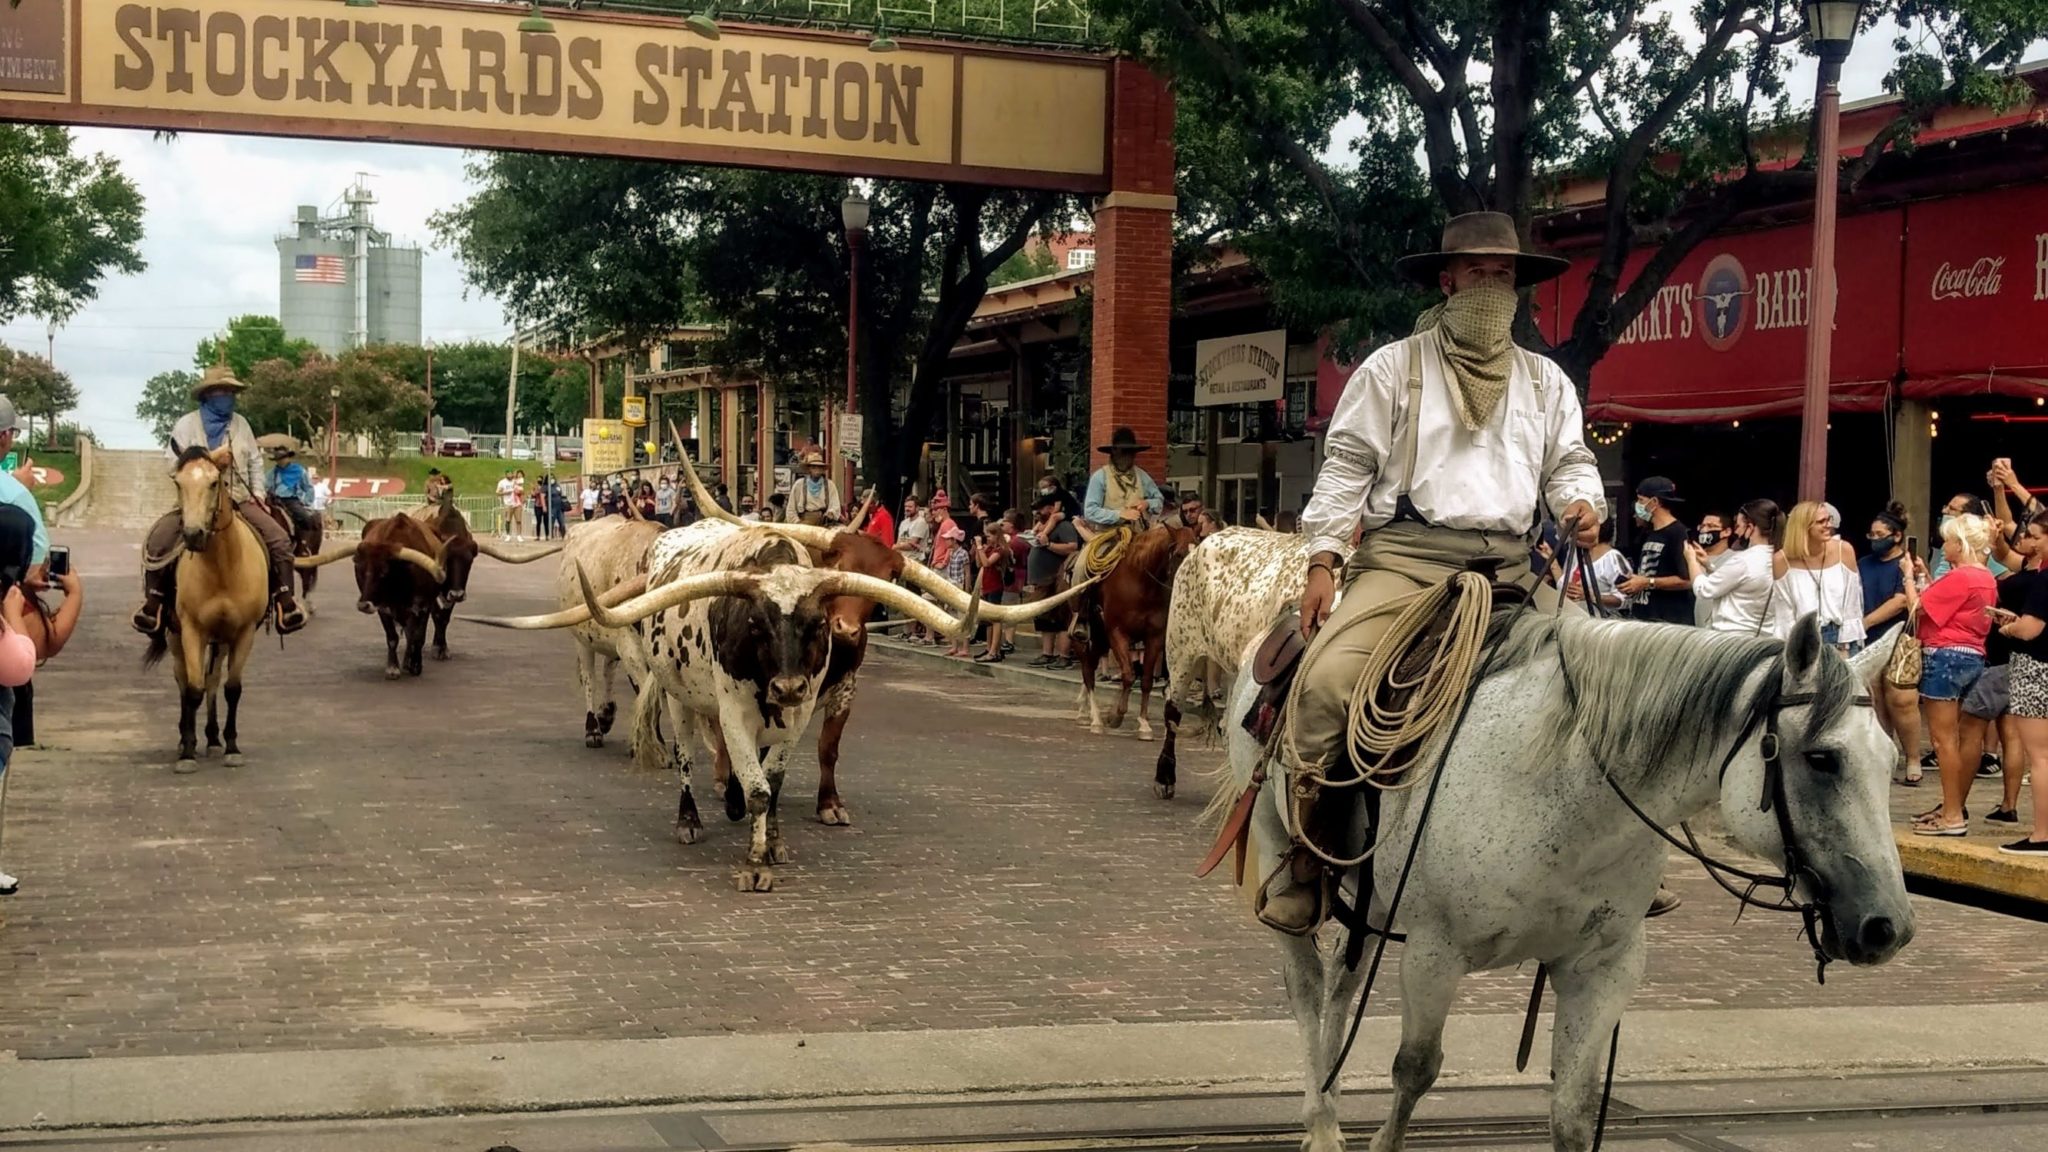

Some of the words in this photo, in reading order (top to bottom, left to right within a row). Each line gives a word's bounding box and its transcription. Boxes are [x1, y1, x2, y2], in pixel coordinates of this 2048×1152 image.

[114, 3, 604, 121] STOCKYARDS
[633, 42, 923, 146] STATION
[1248, 344, 1280, 380] STATION
